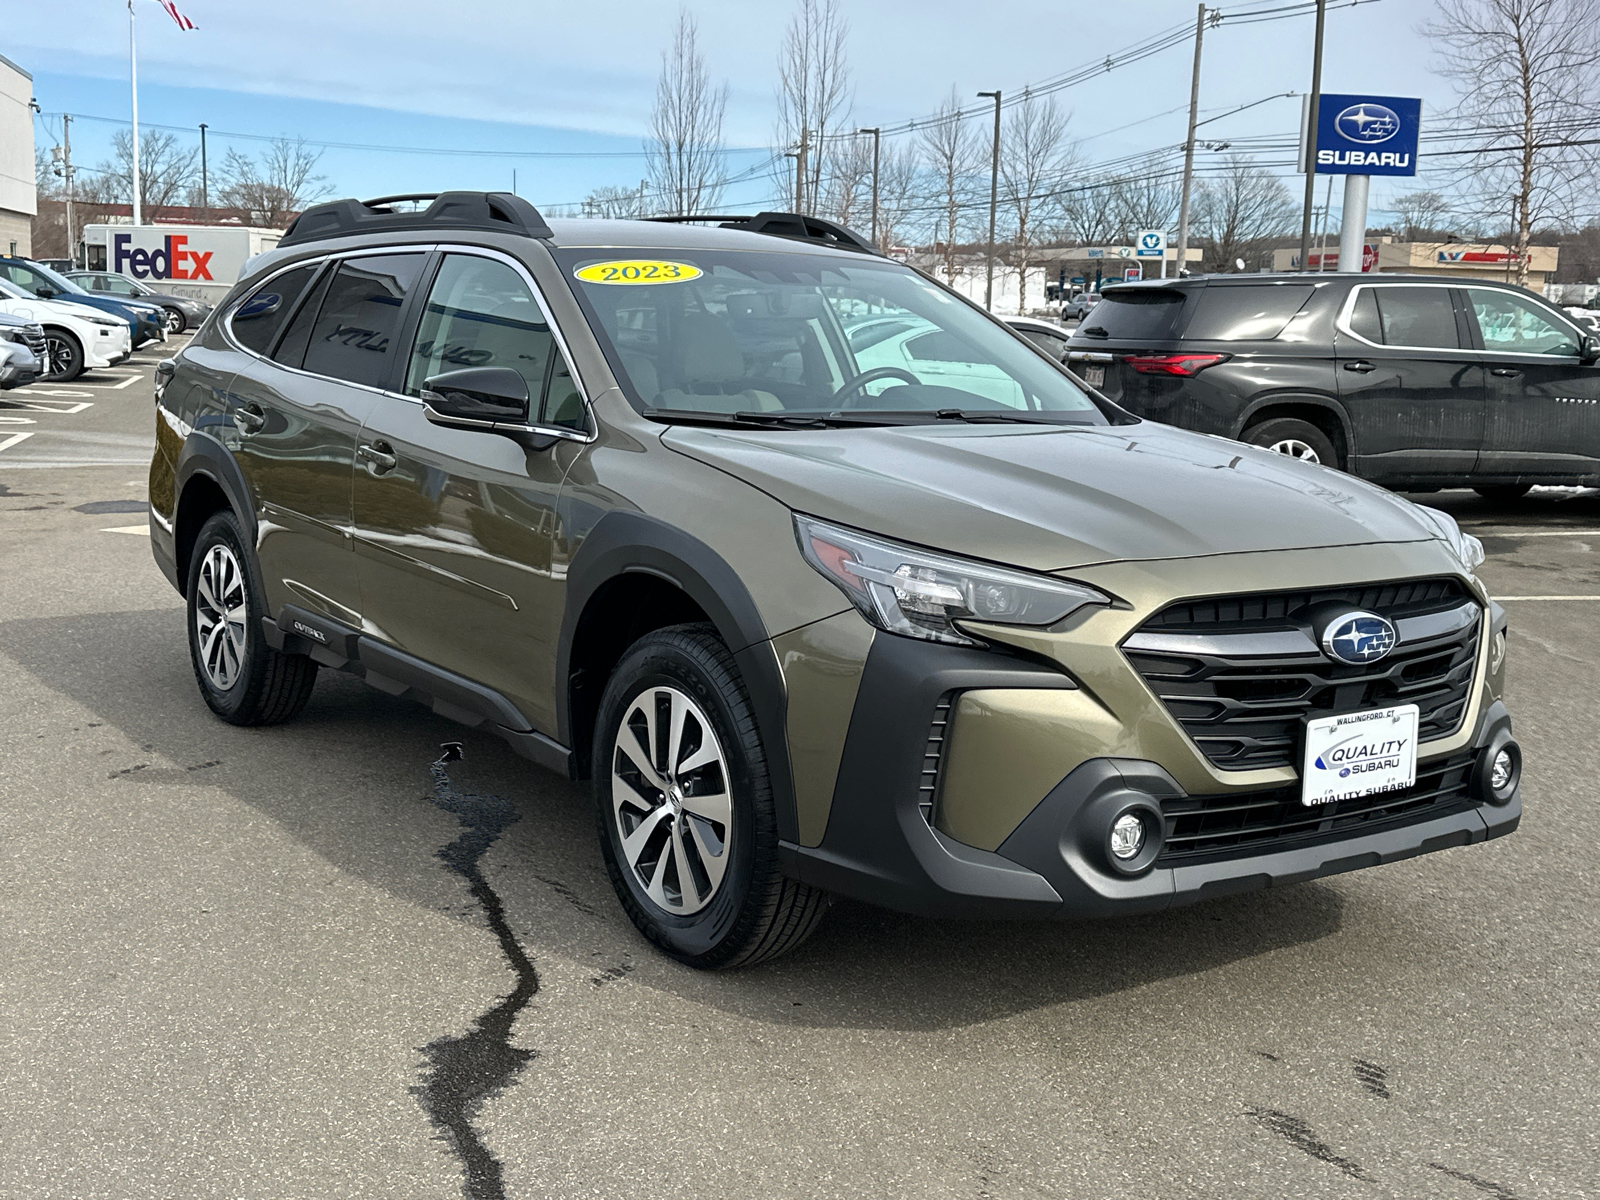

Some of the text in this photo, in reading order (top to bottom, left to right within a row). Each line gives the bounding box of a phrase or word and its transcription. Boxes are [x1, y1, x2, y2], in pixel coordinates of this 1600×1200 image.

[1317, 149, 1410, 168] SUBARU
[114, 233, 214, 281] FedEx
[600, 264, 682, 281] 2023
[1386, 710, 1395, 718] CT
[1331, 738, 1408, 762] QUALITY
[1352, 758, 1399, 774] SUBARU
[1310, 781, 1412, 806] QUALITY SUBARU
